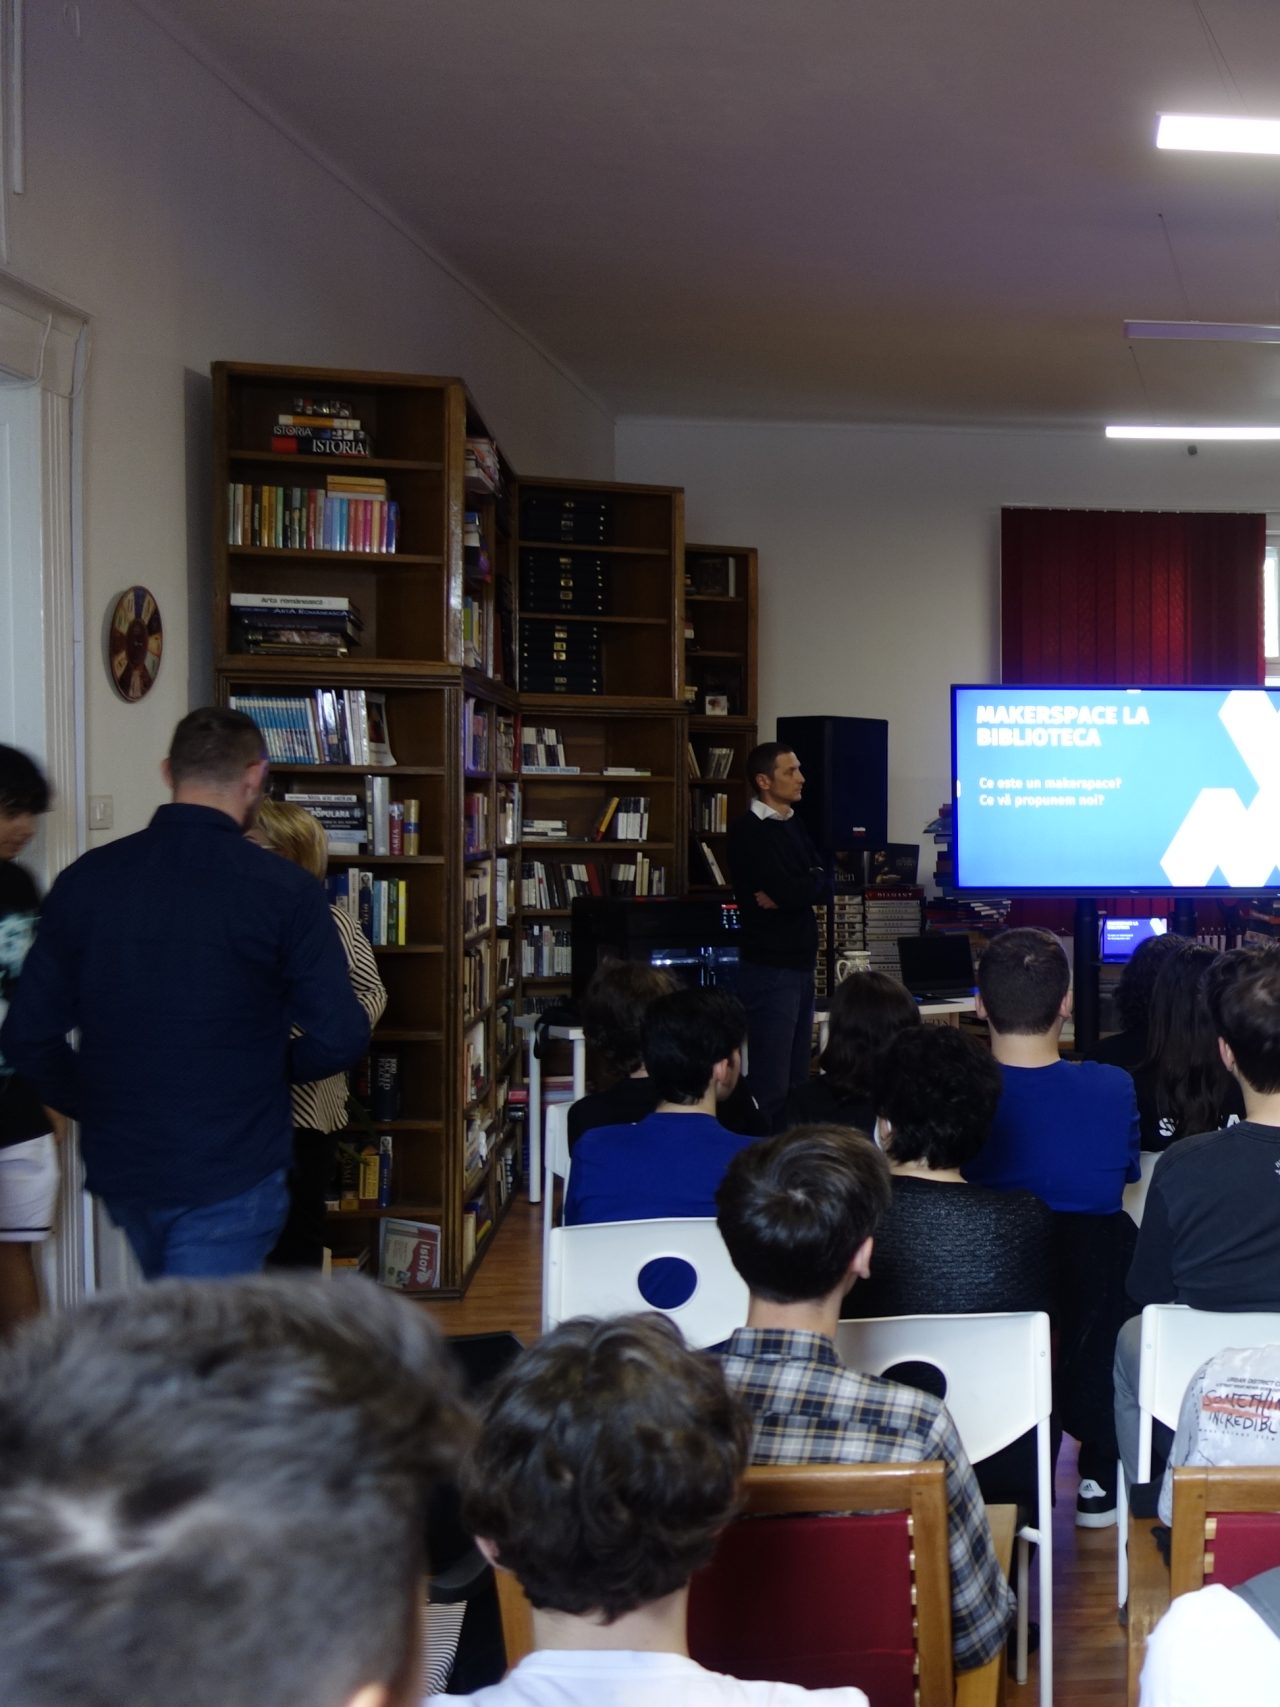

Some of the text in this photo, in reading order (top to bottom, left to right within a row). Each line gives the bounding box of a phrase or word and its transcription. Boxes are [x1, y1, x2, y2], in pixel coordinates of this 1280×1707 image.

[312, 439, 365, 455] ISTORIA
[976, 706, 1150, 725] MAKERSPACE LA
[976, 727, 1101, 747] BIBLIOTECA
[979, 777, 1122, 791] Ce este un makerspace?
[979, 794, 994, 806] Ce
[1014, 795, 1076, 808] propunem
[1079, 794, 1105, 806] noi?
